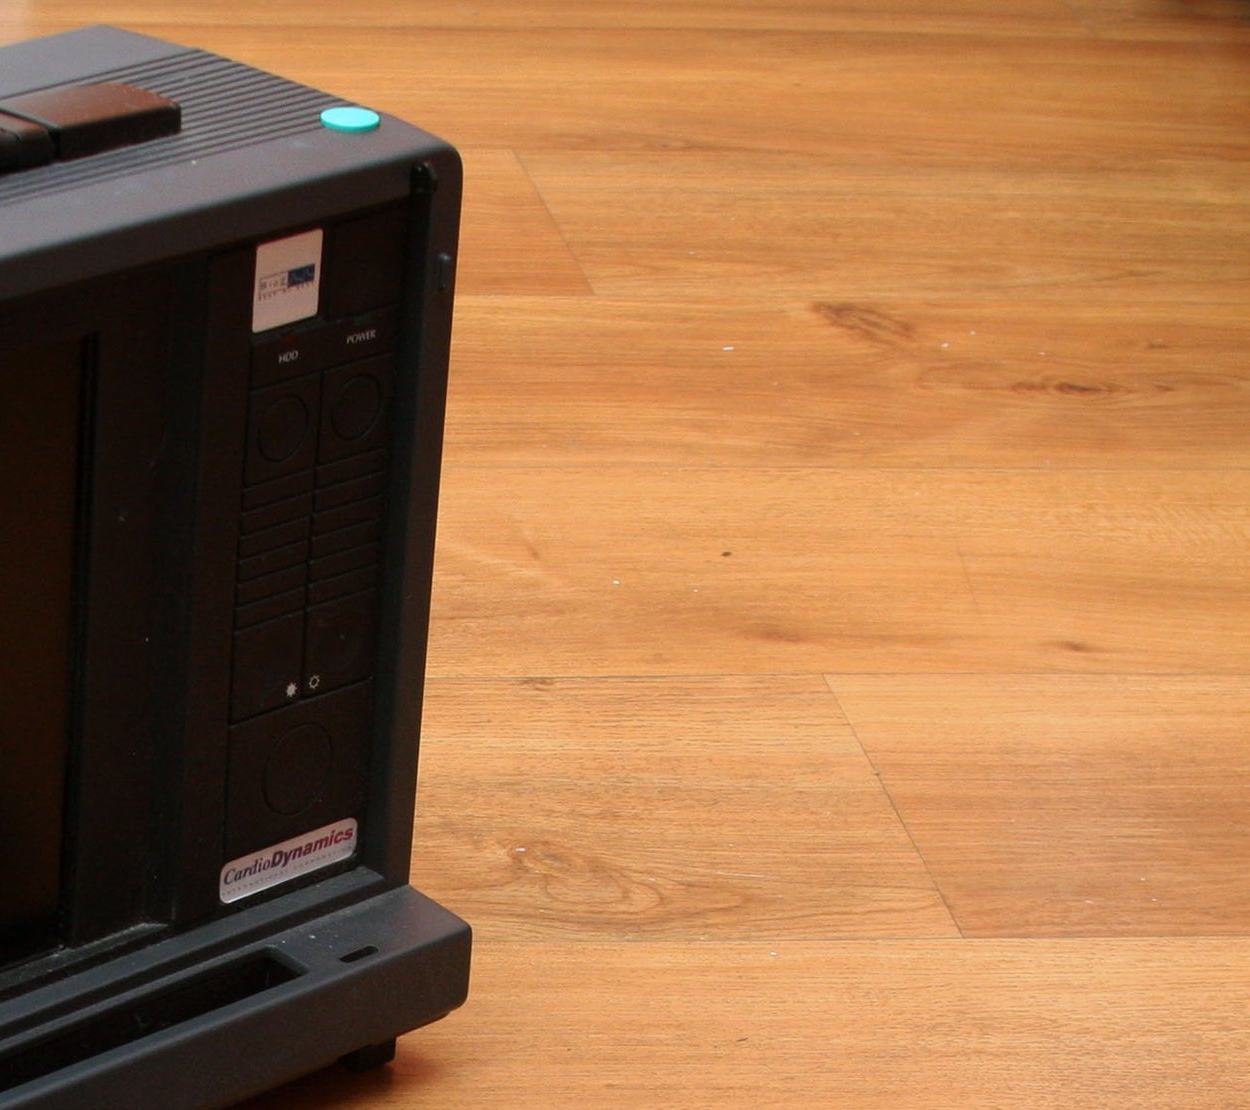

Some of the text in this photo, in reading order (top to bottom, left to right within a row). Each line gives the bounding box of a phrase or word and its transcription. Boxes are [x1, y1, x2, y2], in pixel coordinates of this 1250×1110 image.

[346, 329, 376, 345] POWER
[279, 350, 299, 364] HDD
[223, 827, 354, 885] CardioDynamics
